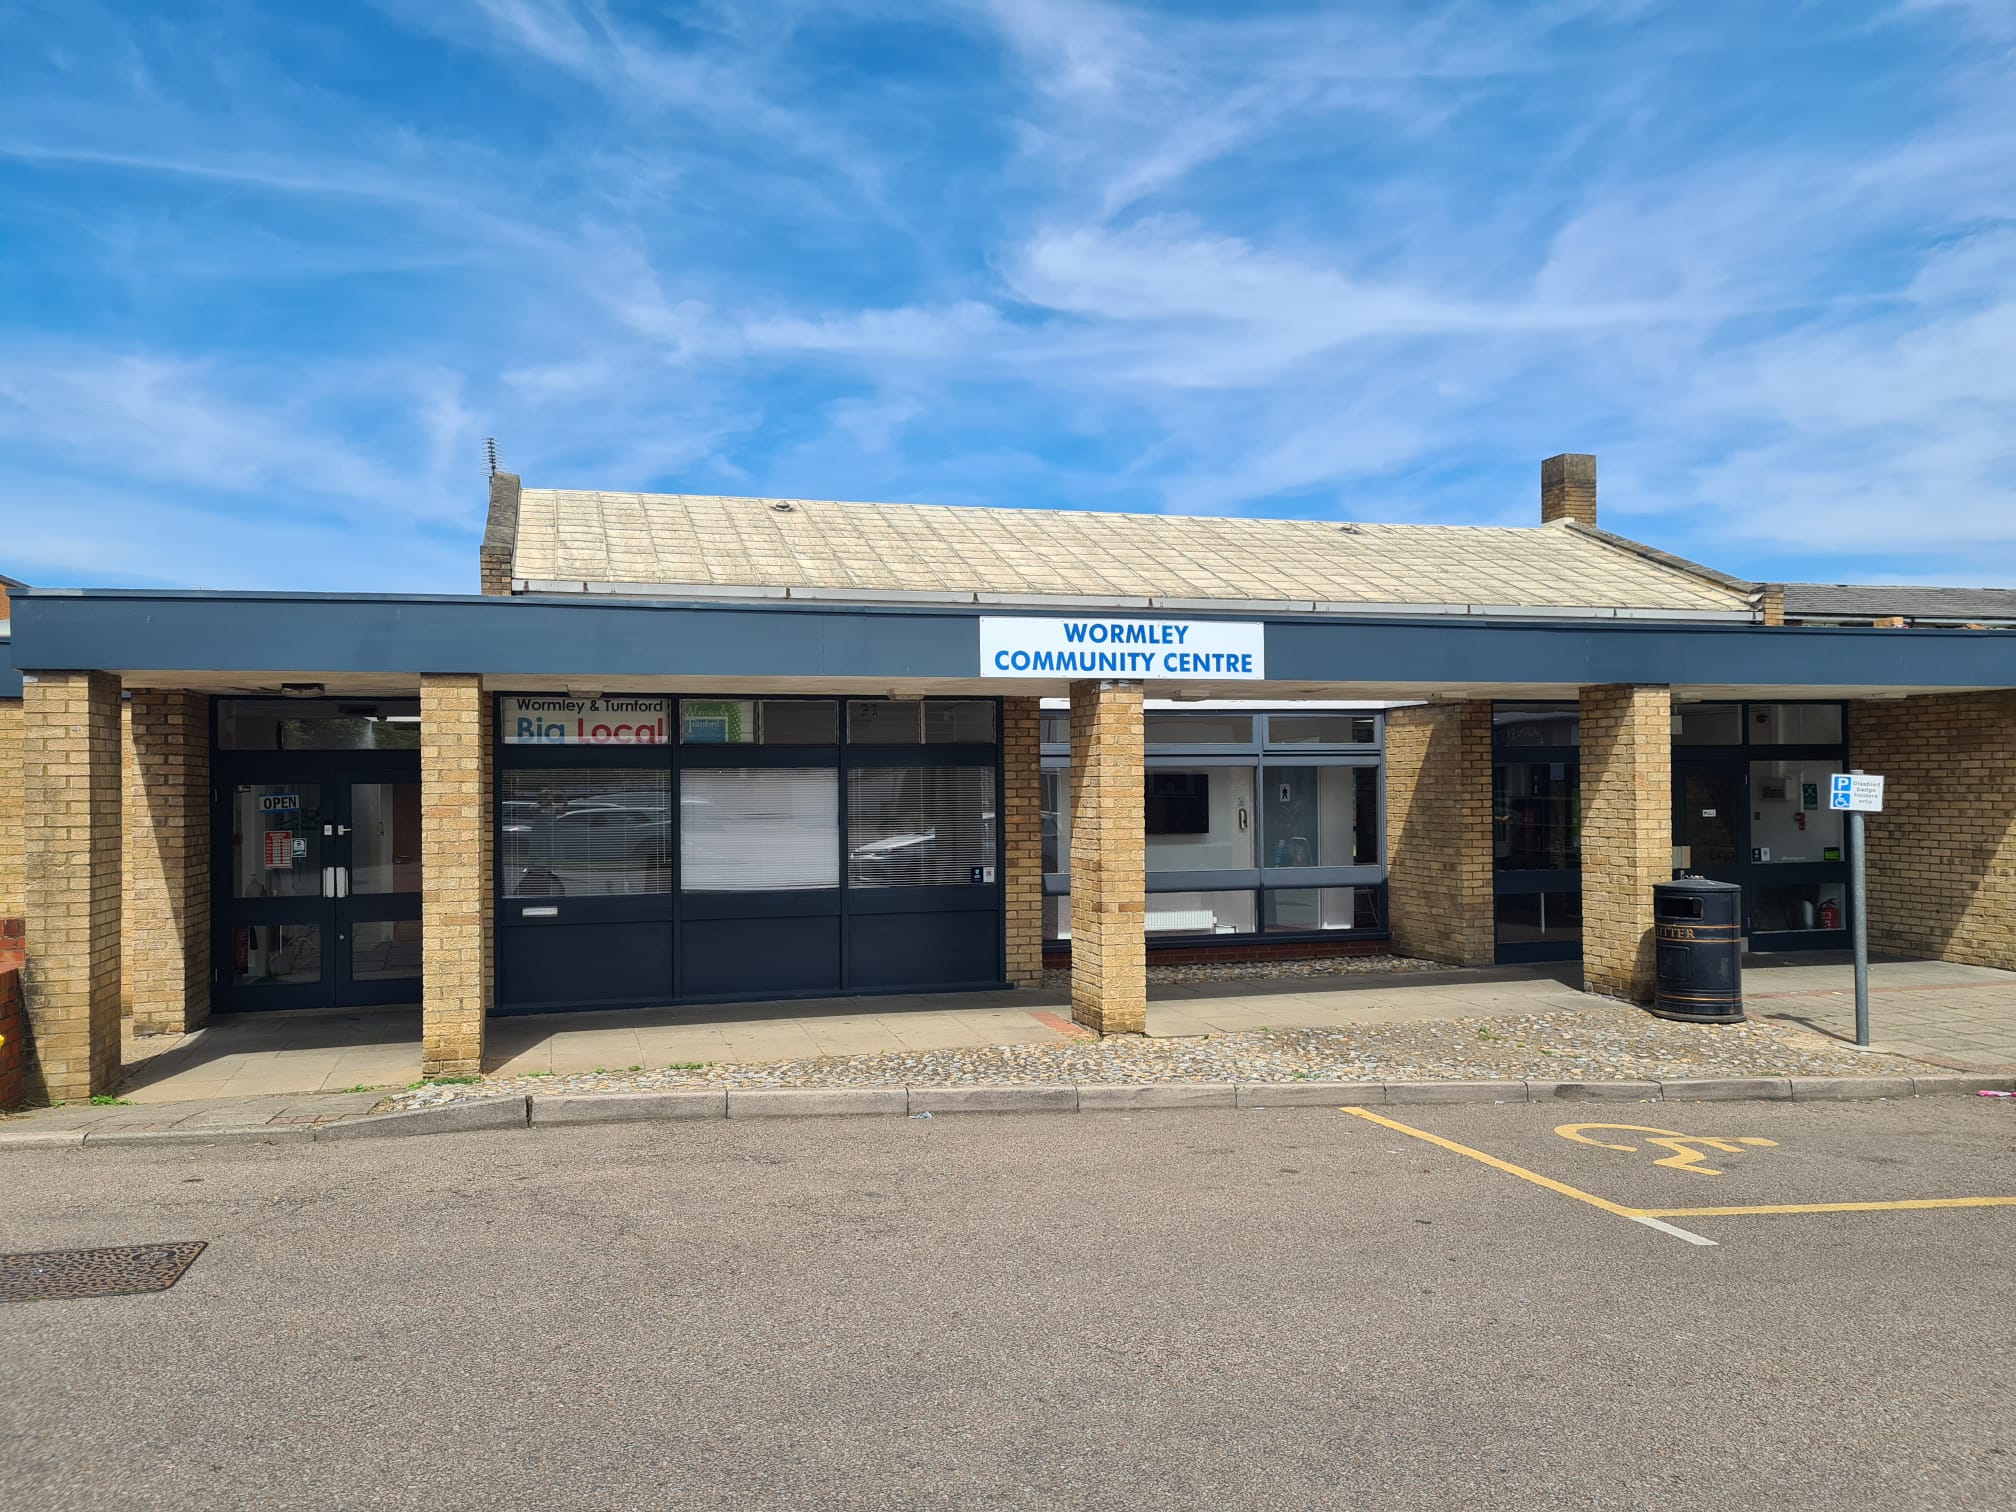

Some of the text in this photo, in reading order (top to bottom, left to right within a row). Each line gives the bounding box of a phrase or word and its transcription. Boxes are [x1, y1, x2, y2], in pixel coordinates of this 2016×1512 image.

[1063, 623, 1189, 644] WORMLEY
[994, 650, 1253, 673] COMMUNITY CENTRE
[516, 698, 663, 714] Wormley & Turnford
[517, 717, 664, 744] Big Local
[1838, 777, 1849, 790] P
[263, 796, 297, 809] OPEN
